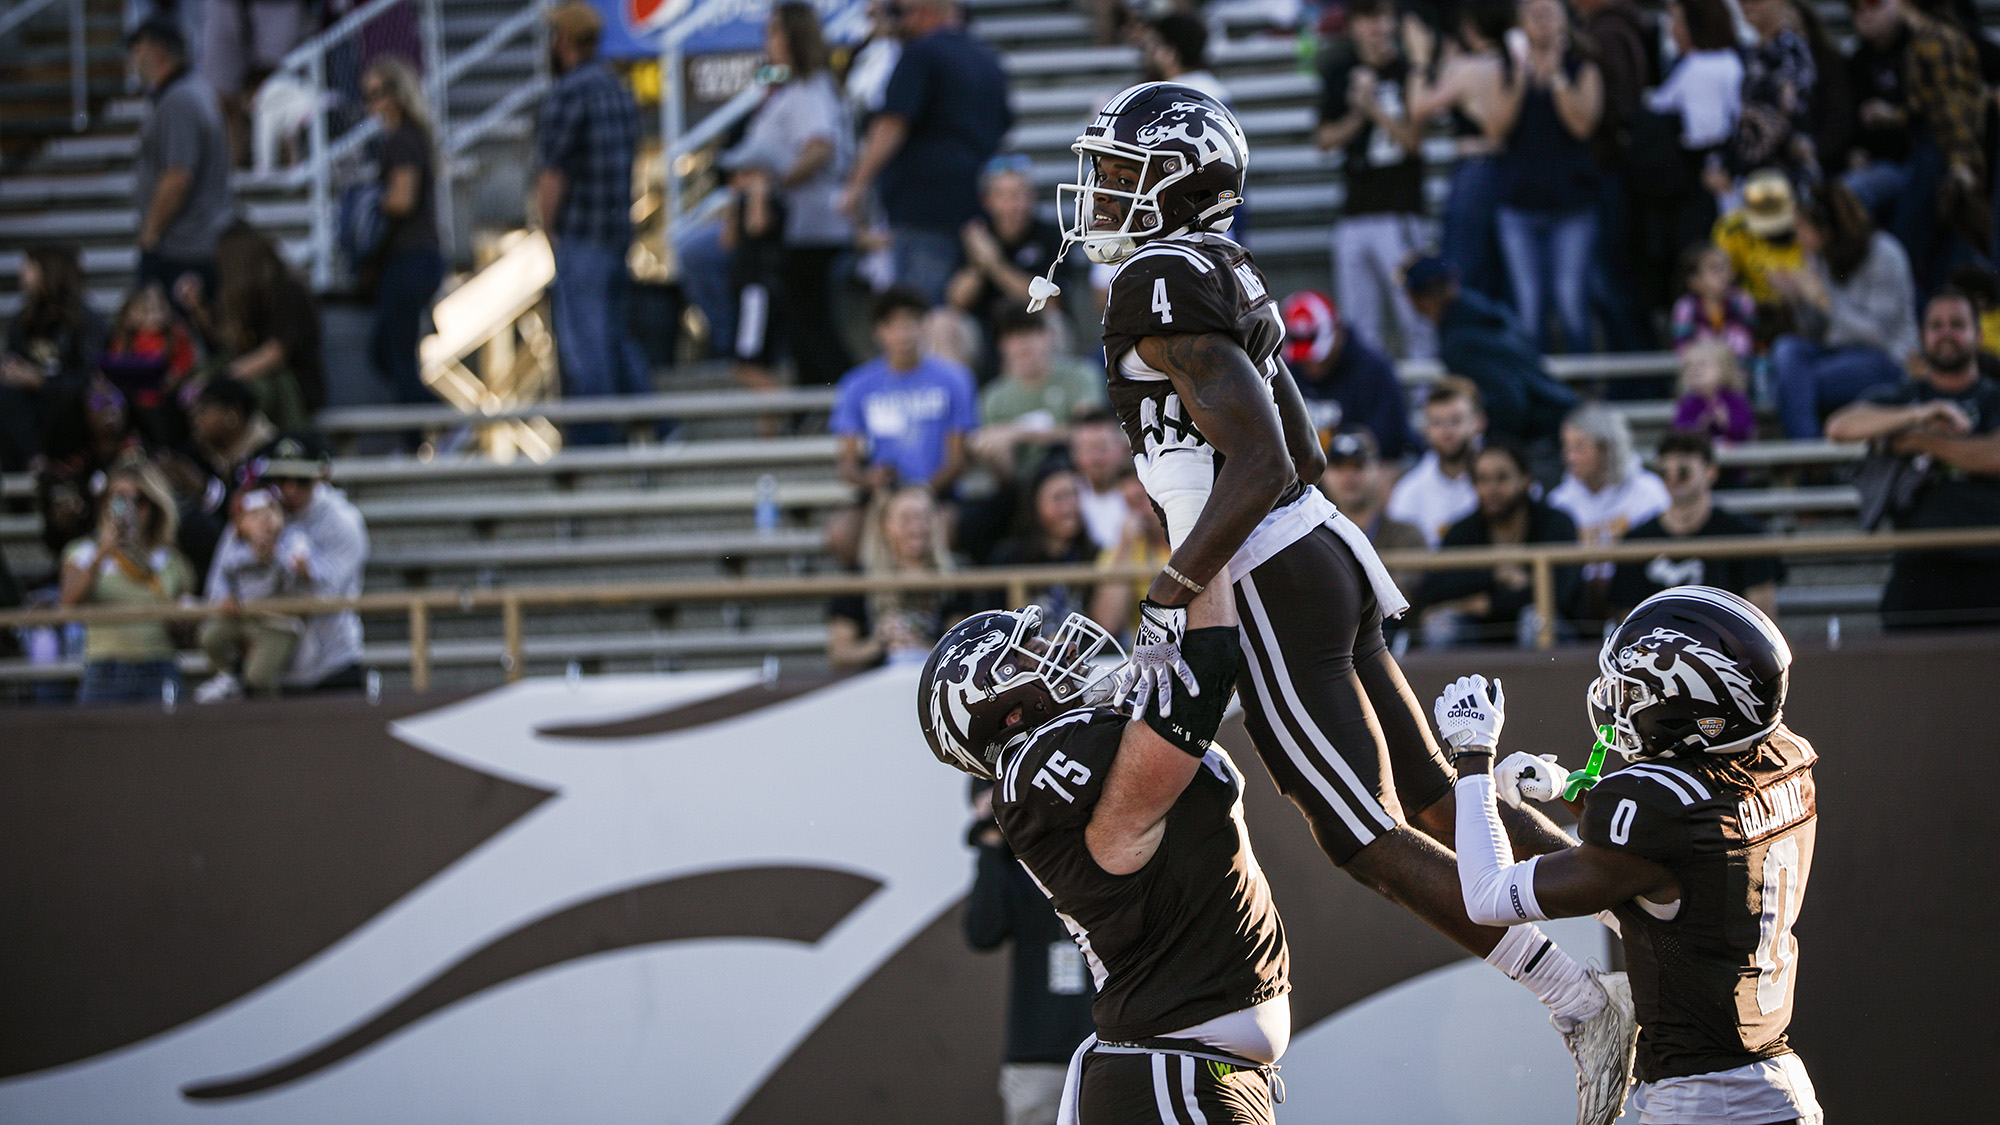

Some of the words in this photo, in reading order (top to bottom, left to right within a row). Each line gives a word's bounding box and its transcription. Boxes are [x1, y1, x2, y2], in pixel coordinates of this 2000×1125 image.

[1152, 277, 1173, 324] 4
[1141, 621, 1161, 643] adida
[1447, 709, 1485, 721] adidas
[1031, 750, 1092, 804] 75
[1610, 798, 1637, 845] 0
[1756, 835, 1799, 1016] 0
